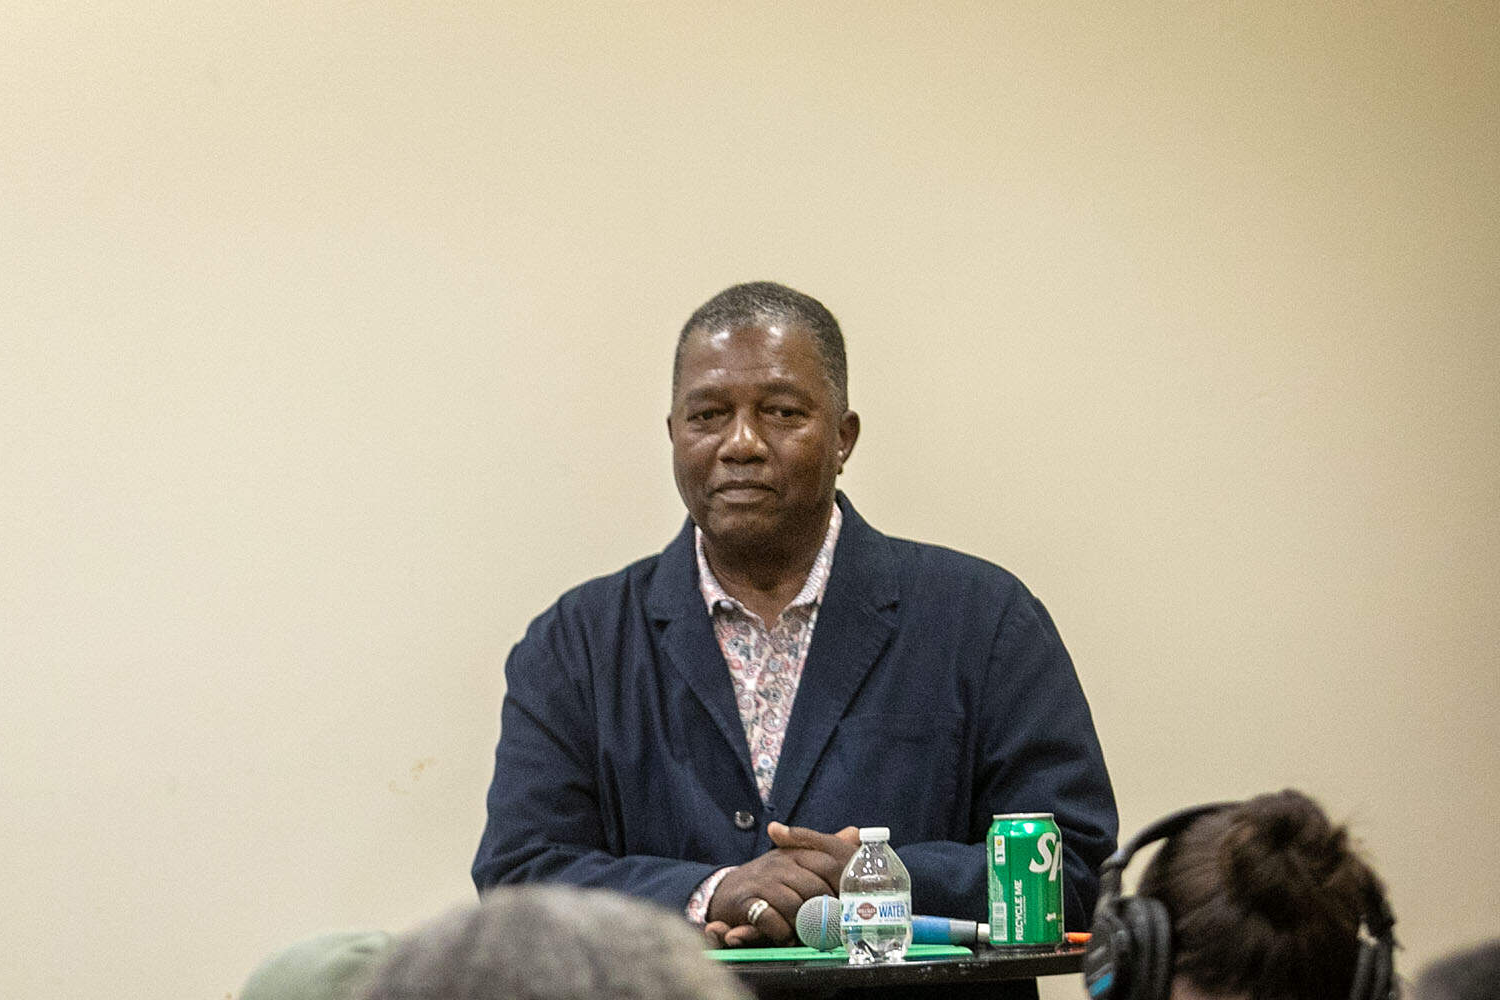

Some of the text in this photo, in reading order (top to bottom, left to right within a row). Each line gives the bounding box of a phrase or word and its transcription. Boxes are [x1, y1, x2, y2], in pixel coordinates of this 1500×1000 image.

[878, 904, 906, 918] WATER
[1013, 879, 1024, 941] RECYCLE ME
